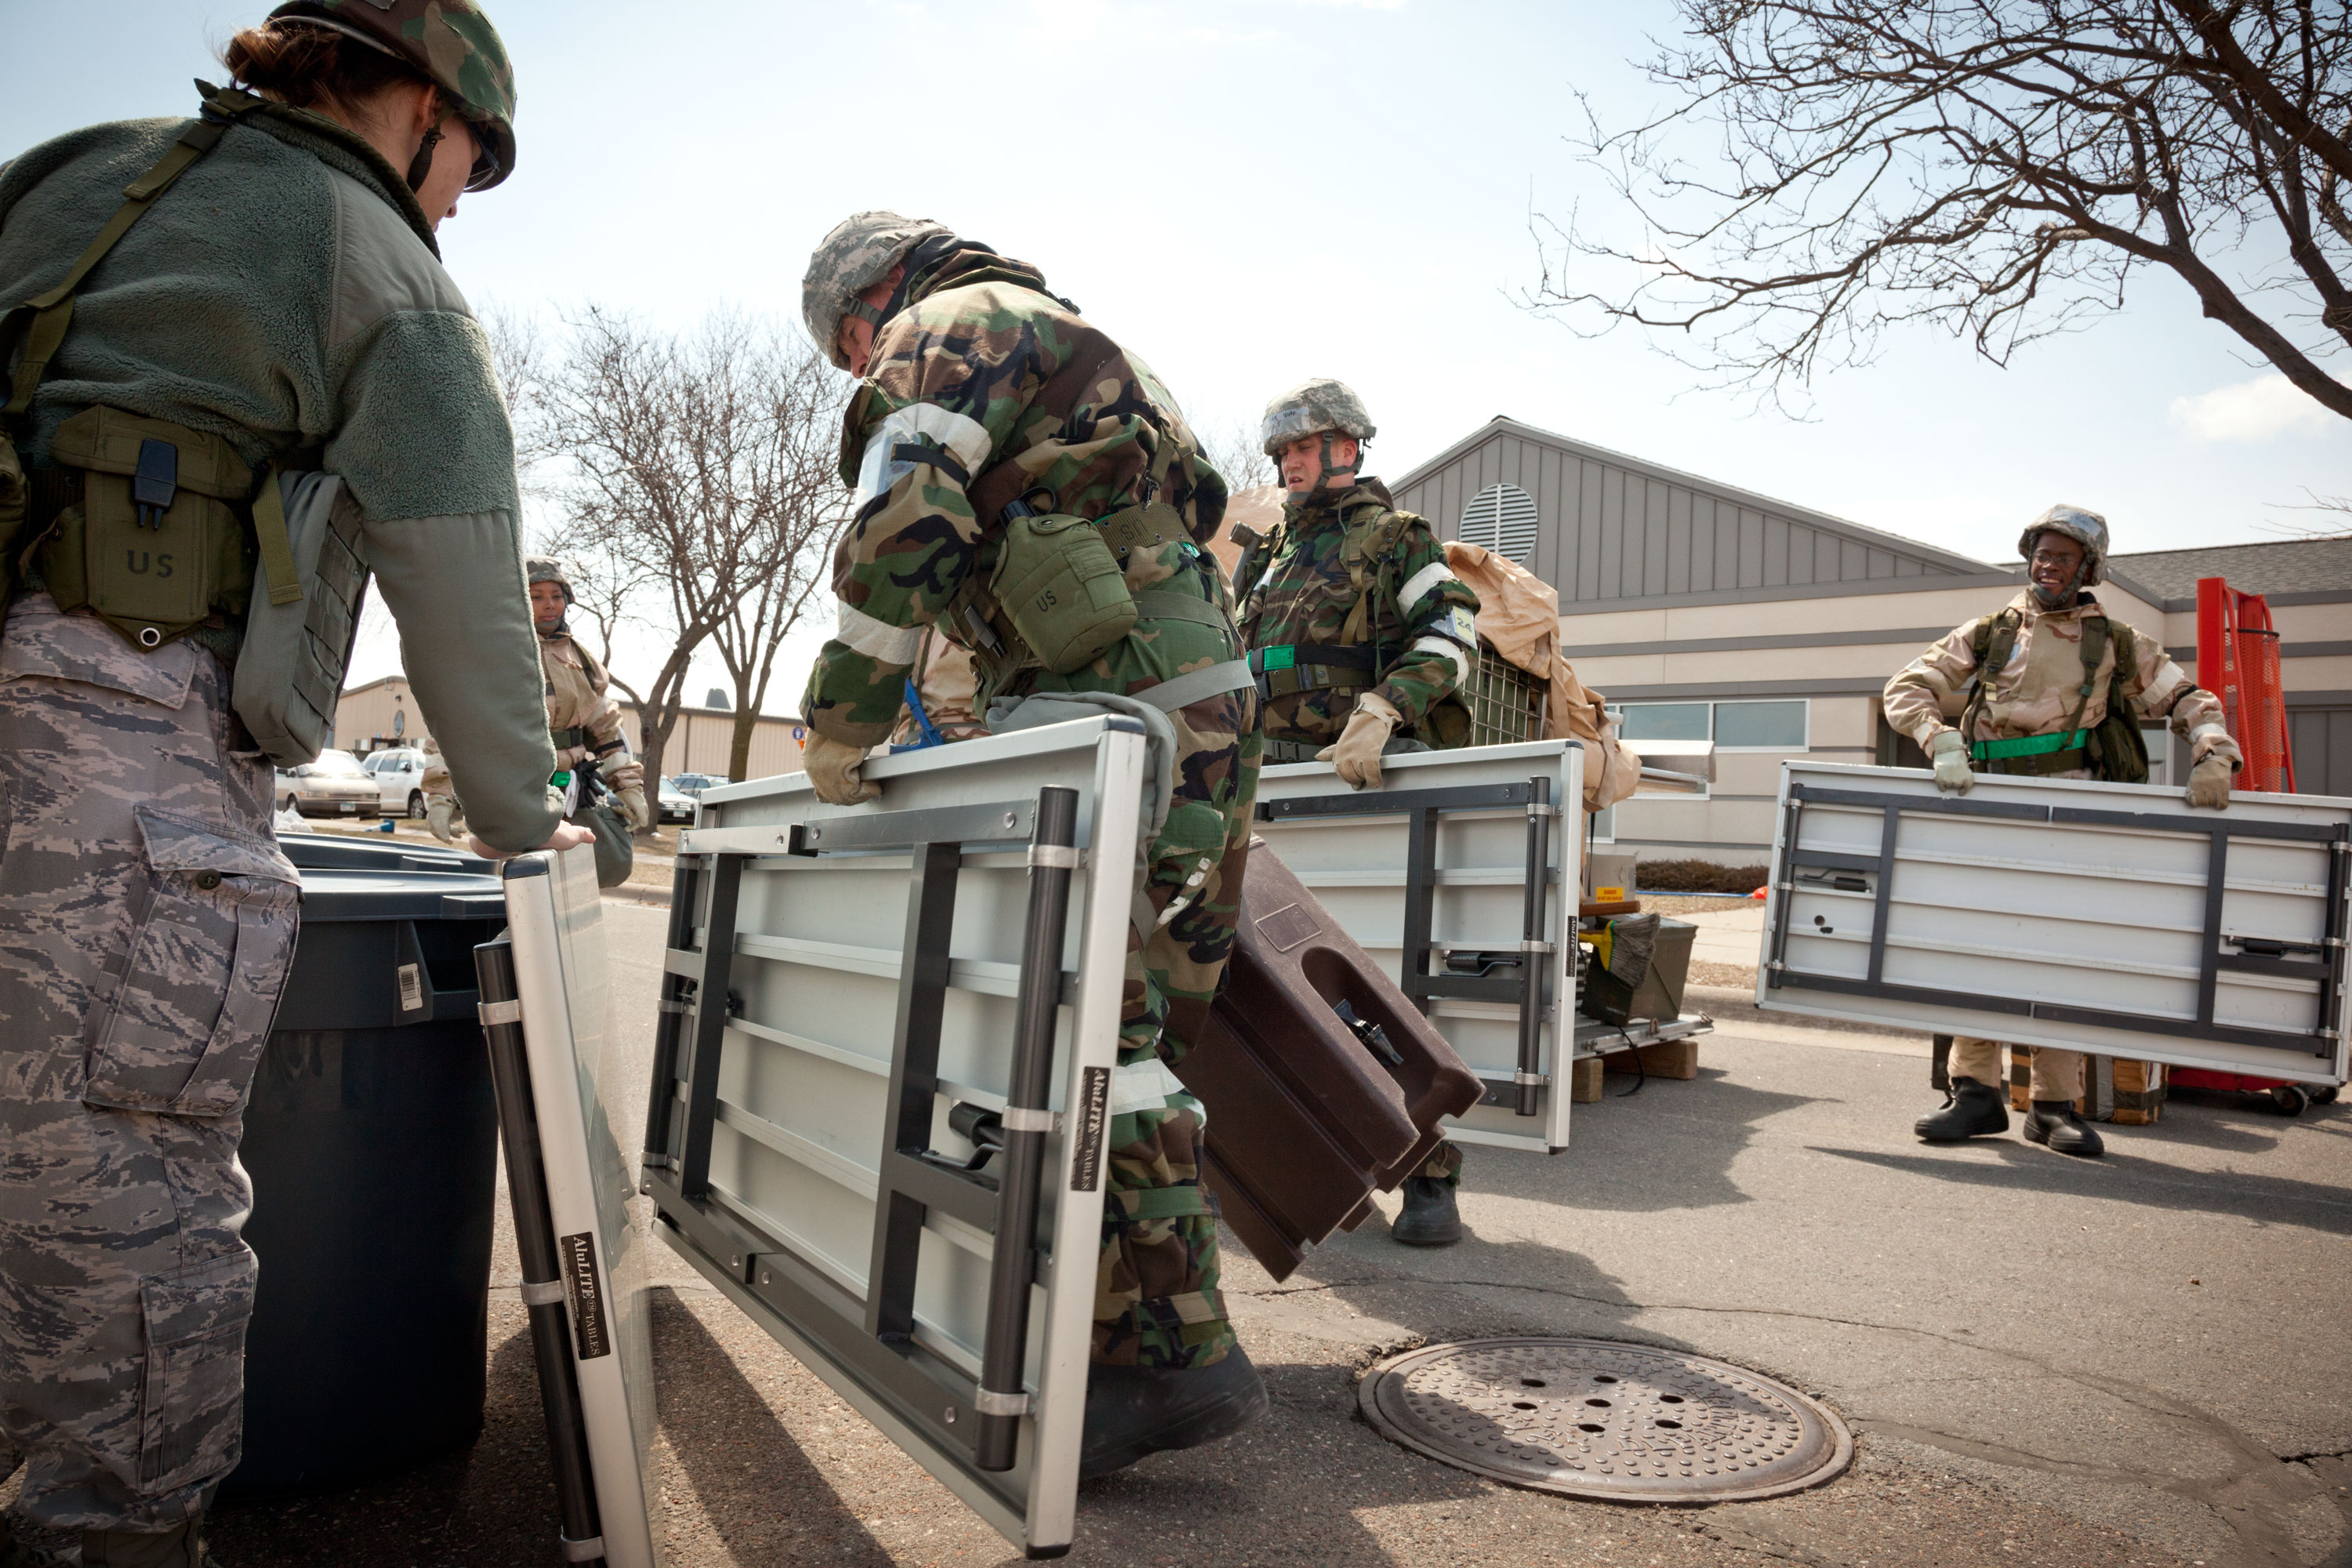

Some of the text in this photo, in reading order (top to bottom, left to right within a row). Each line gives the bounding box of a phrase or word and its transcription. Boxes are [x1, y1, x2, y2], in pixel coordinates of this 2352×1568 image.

[127, 550, 173, 578] US
[1036, 590, 1057, 612] US
[1457, 617, 1472, 632] 24
[1082, 1149, 1094, 1190] TABLES
[573, 1236, 595, 1299] AluLITE
[586, 1313, 600, 1356] TABLES
